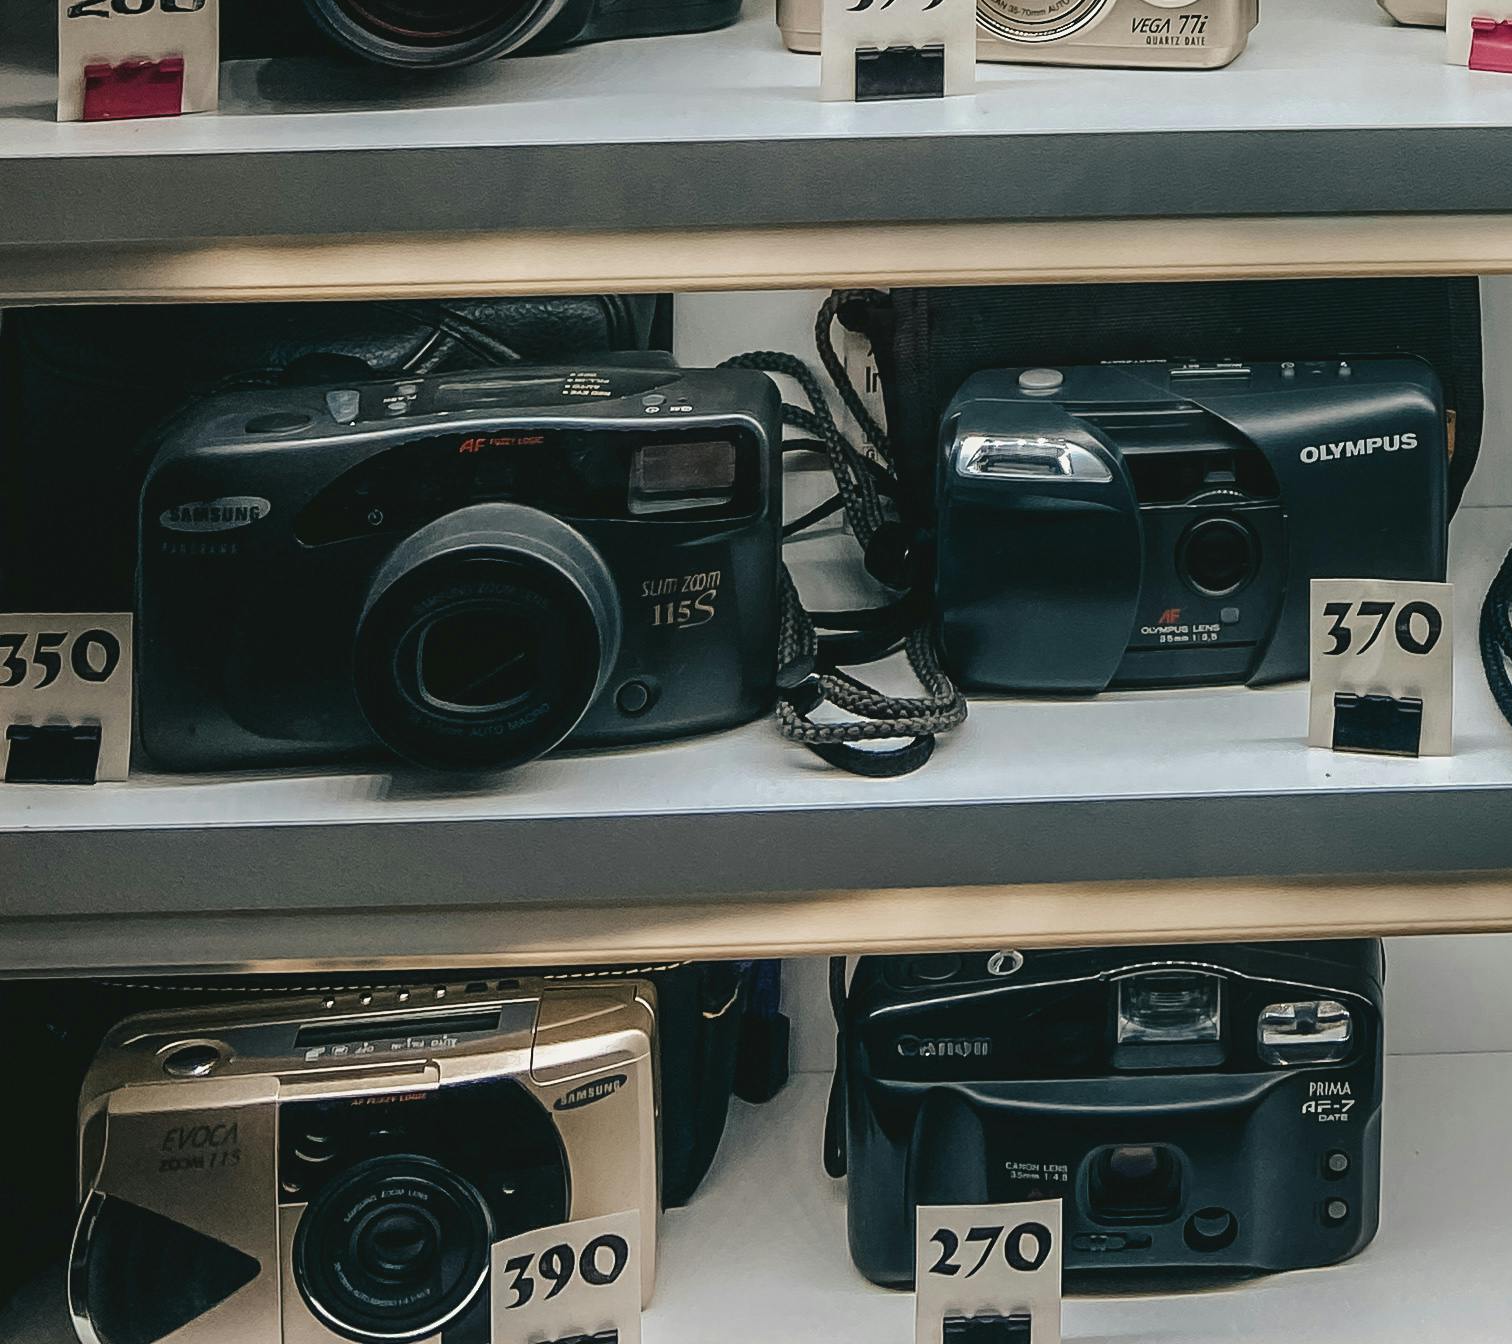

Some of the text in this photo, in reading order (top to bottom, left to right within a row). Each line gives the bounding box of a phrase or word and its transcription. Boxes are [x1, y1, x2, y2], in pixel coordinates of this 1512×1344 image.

[458, 437, 488, 454] AF
[1300, 432, 1419, 464] OLYMPUS
[1322, 600, 1442, 656] 370
[0, 628, 121, 690] 350
[560, 1080, 621, 1107] SAMSUNG
[1308, 1080, 1352, 1097] PRIMA
[1318, 1113, 1349, 1123] DATE
[929, 1220, 1053, 1279] 270
[503, 1233, 629, 1310] 390
